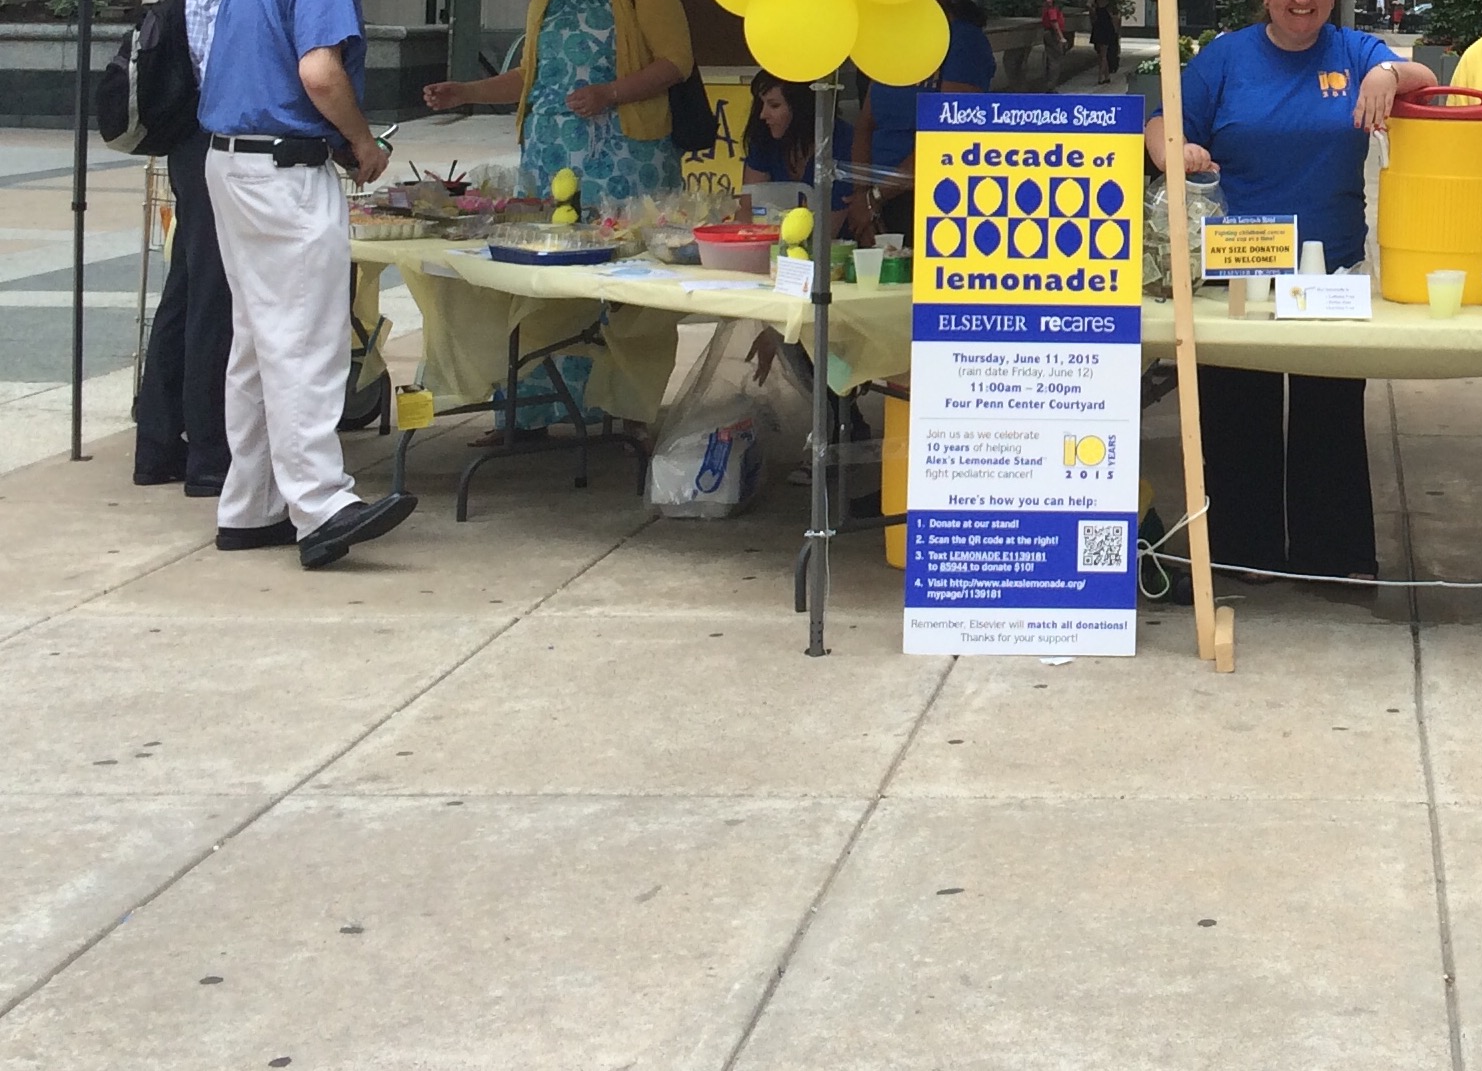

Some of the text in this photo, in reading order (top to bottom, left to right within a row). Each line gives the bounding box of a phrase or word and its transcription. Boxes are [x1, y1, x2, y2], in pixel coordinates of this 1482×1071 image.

[939, 101, 1117, 126] Alex's Lemonade Stand
[940, 142, 1116, 168] a decade of
[1211, 246, 1226, 254] ANY
[1250, 245, 1290, 253] DONATION
[1224, 256, 1232, 264] IS
[935, 266, 1119, 292] lemonade!
[938, 314, 1115, 333] ELSEVIER recares
[952, 352, 1099, 365] Thursday, June 11, 2015
[958, 366, 1094, 379] (rain date Friday, June 12)
[971, 382, 1022, 392] 11:00am
[1036, 383, 1082, 395] 2:00pm
[945, 398, 1105, 412] Four Penn Center Courtyard
[926, 430, 946, 439] Join
[977, 432, 991, 440] we
[994, 430, 1040, 440] celebrate
[927, 442, 1022, 454] 10 years of helping
[1108, 434, 1116, 466] YEARS
[926, 456, 955, 465] Alex's
[959, 456, 1010, 466] Lemonade
[925, 469, 1033, 480] fight pediatric cancer!
[949, 495, 1097, 508] Here's how you can help:
[917, 519, 1019, 528] 1. Donate at our stand!
[916, 535, 1058, 546] 2. Scan the QR code at the right!
[915, 551, 924, 560] 3.
[928, 551, 947, 560] Text
[928, 563, 938, 571] to
[970, 563, 979, 572] to
[981, 563, 1012, 572] donate
[914, 579, 923, 587] 4.
[928, 579, 947, 587] Visit
[911, 619, 1128, 630] Remember, Elsevier will match all donations!
[961, 633, 1078, 644] Thanks for your support!
